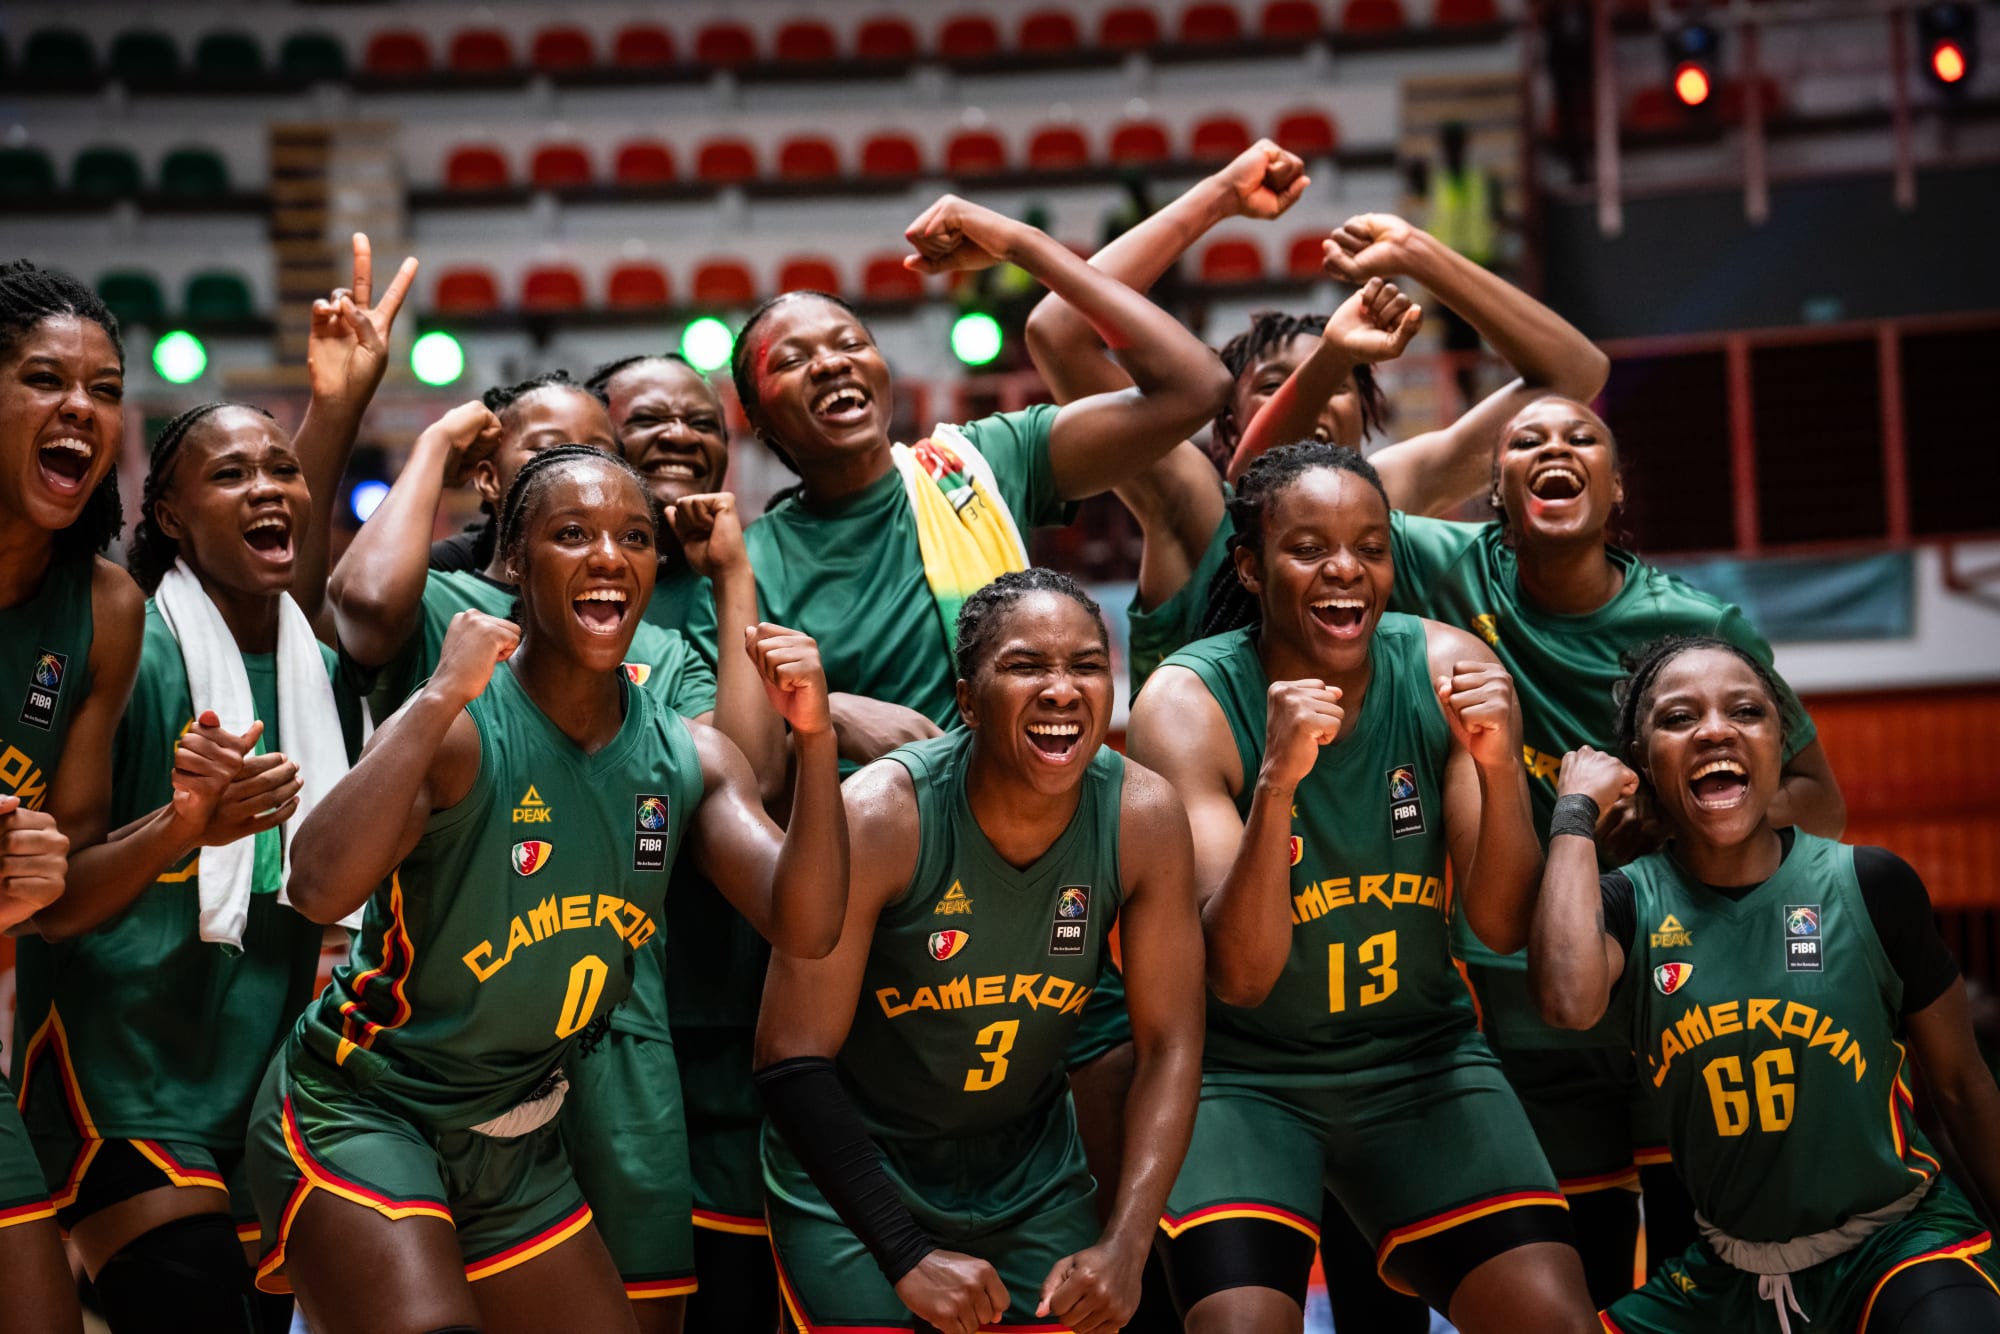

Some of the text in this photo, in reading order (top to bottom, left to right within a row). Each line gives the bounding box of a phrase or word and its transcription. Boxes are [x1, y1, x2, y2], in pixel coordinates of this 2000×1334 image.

[30, 692, 52, 710] FIBA
[512, 807, 553, 823] PEAK
[1394, 804, 1417, 820] FIBA
[640, 838, 662, 851] FIBA
[933, 899, 974, 915] PEAK
[461, 892, 657, 984] CAMEROO
[1057, 926, 1081, 938] FIBA
[1651, 931, 1693, 948] PEAK
[1791, 942, 1817, 954] FIBA
[1328, 929, 1398, 1014] 13
[554, 954, 609, 1040] 0
[963, 1019, 1020, 1092] 3
[1702, 1047, 1795, 1137] 66
